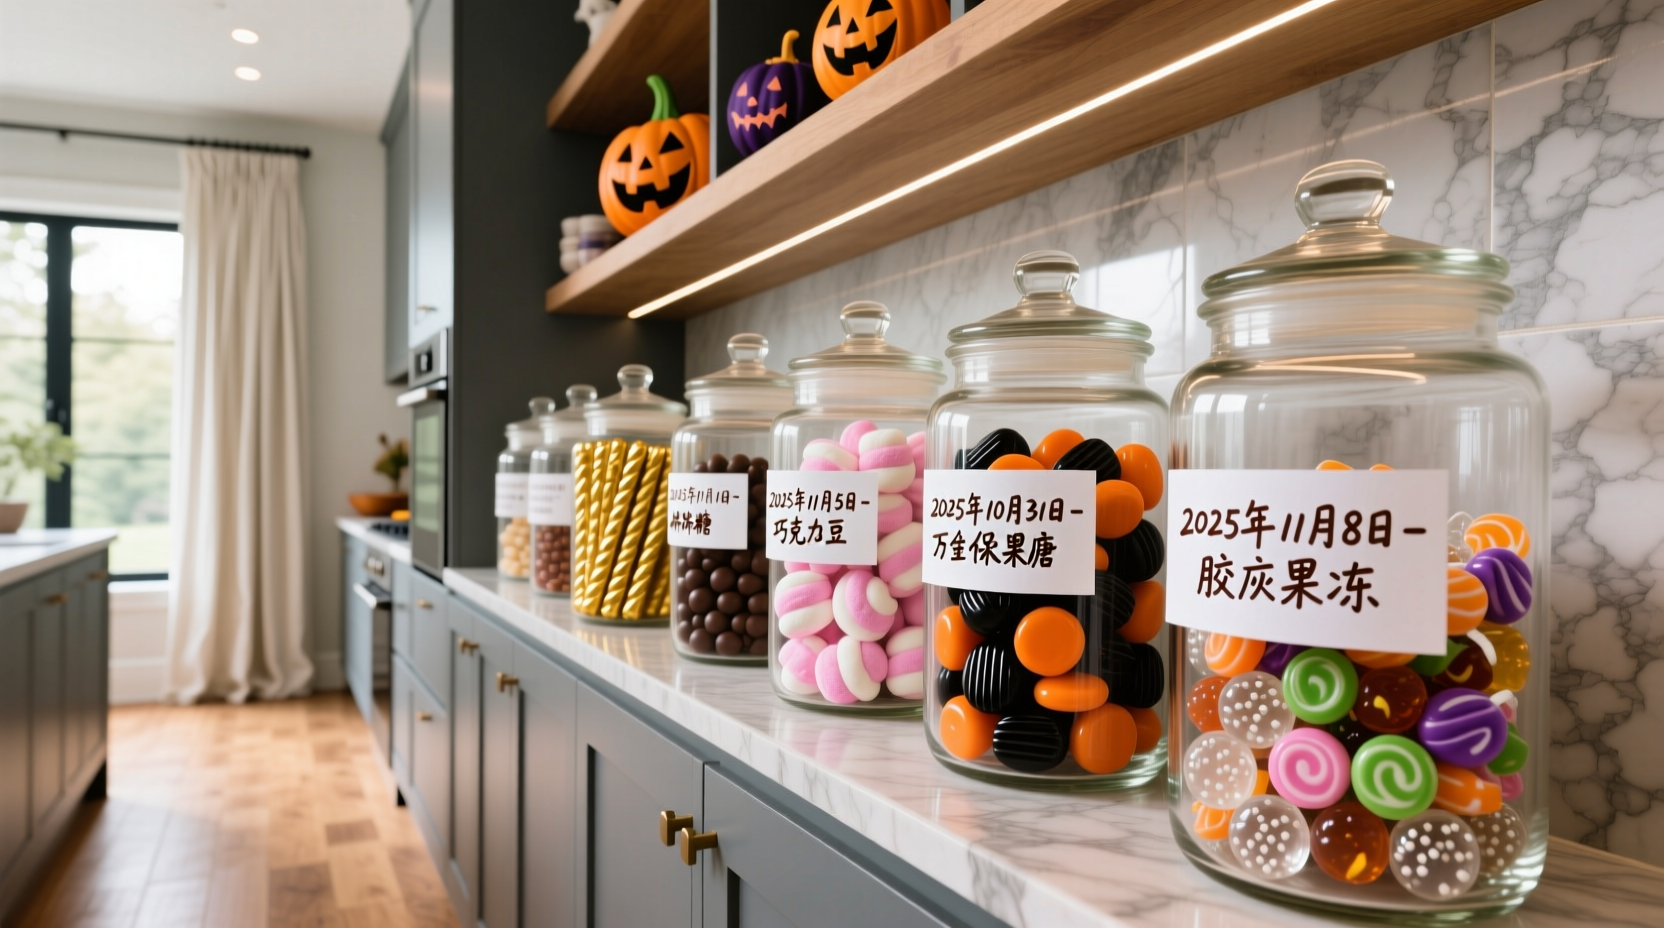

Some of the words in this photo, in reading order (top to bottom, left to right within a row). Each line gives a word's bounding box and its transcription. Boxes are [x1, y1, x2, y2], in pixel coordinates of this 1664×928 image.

[773, 515, 847, 546] 巧克力豆
[1197, 552, 1380, 614] 胶灰果冻
